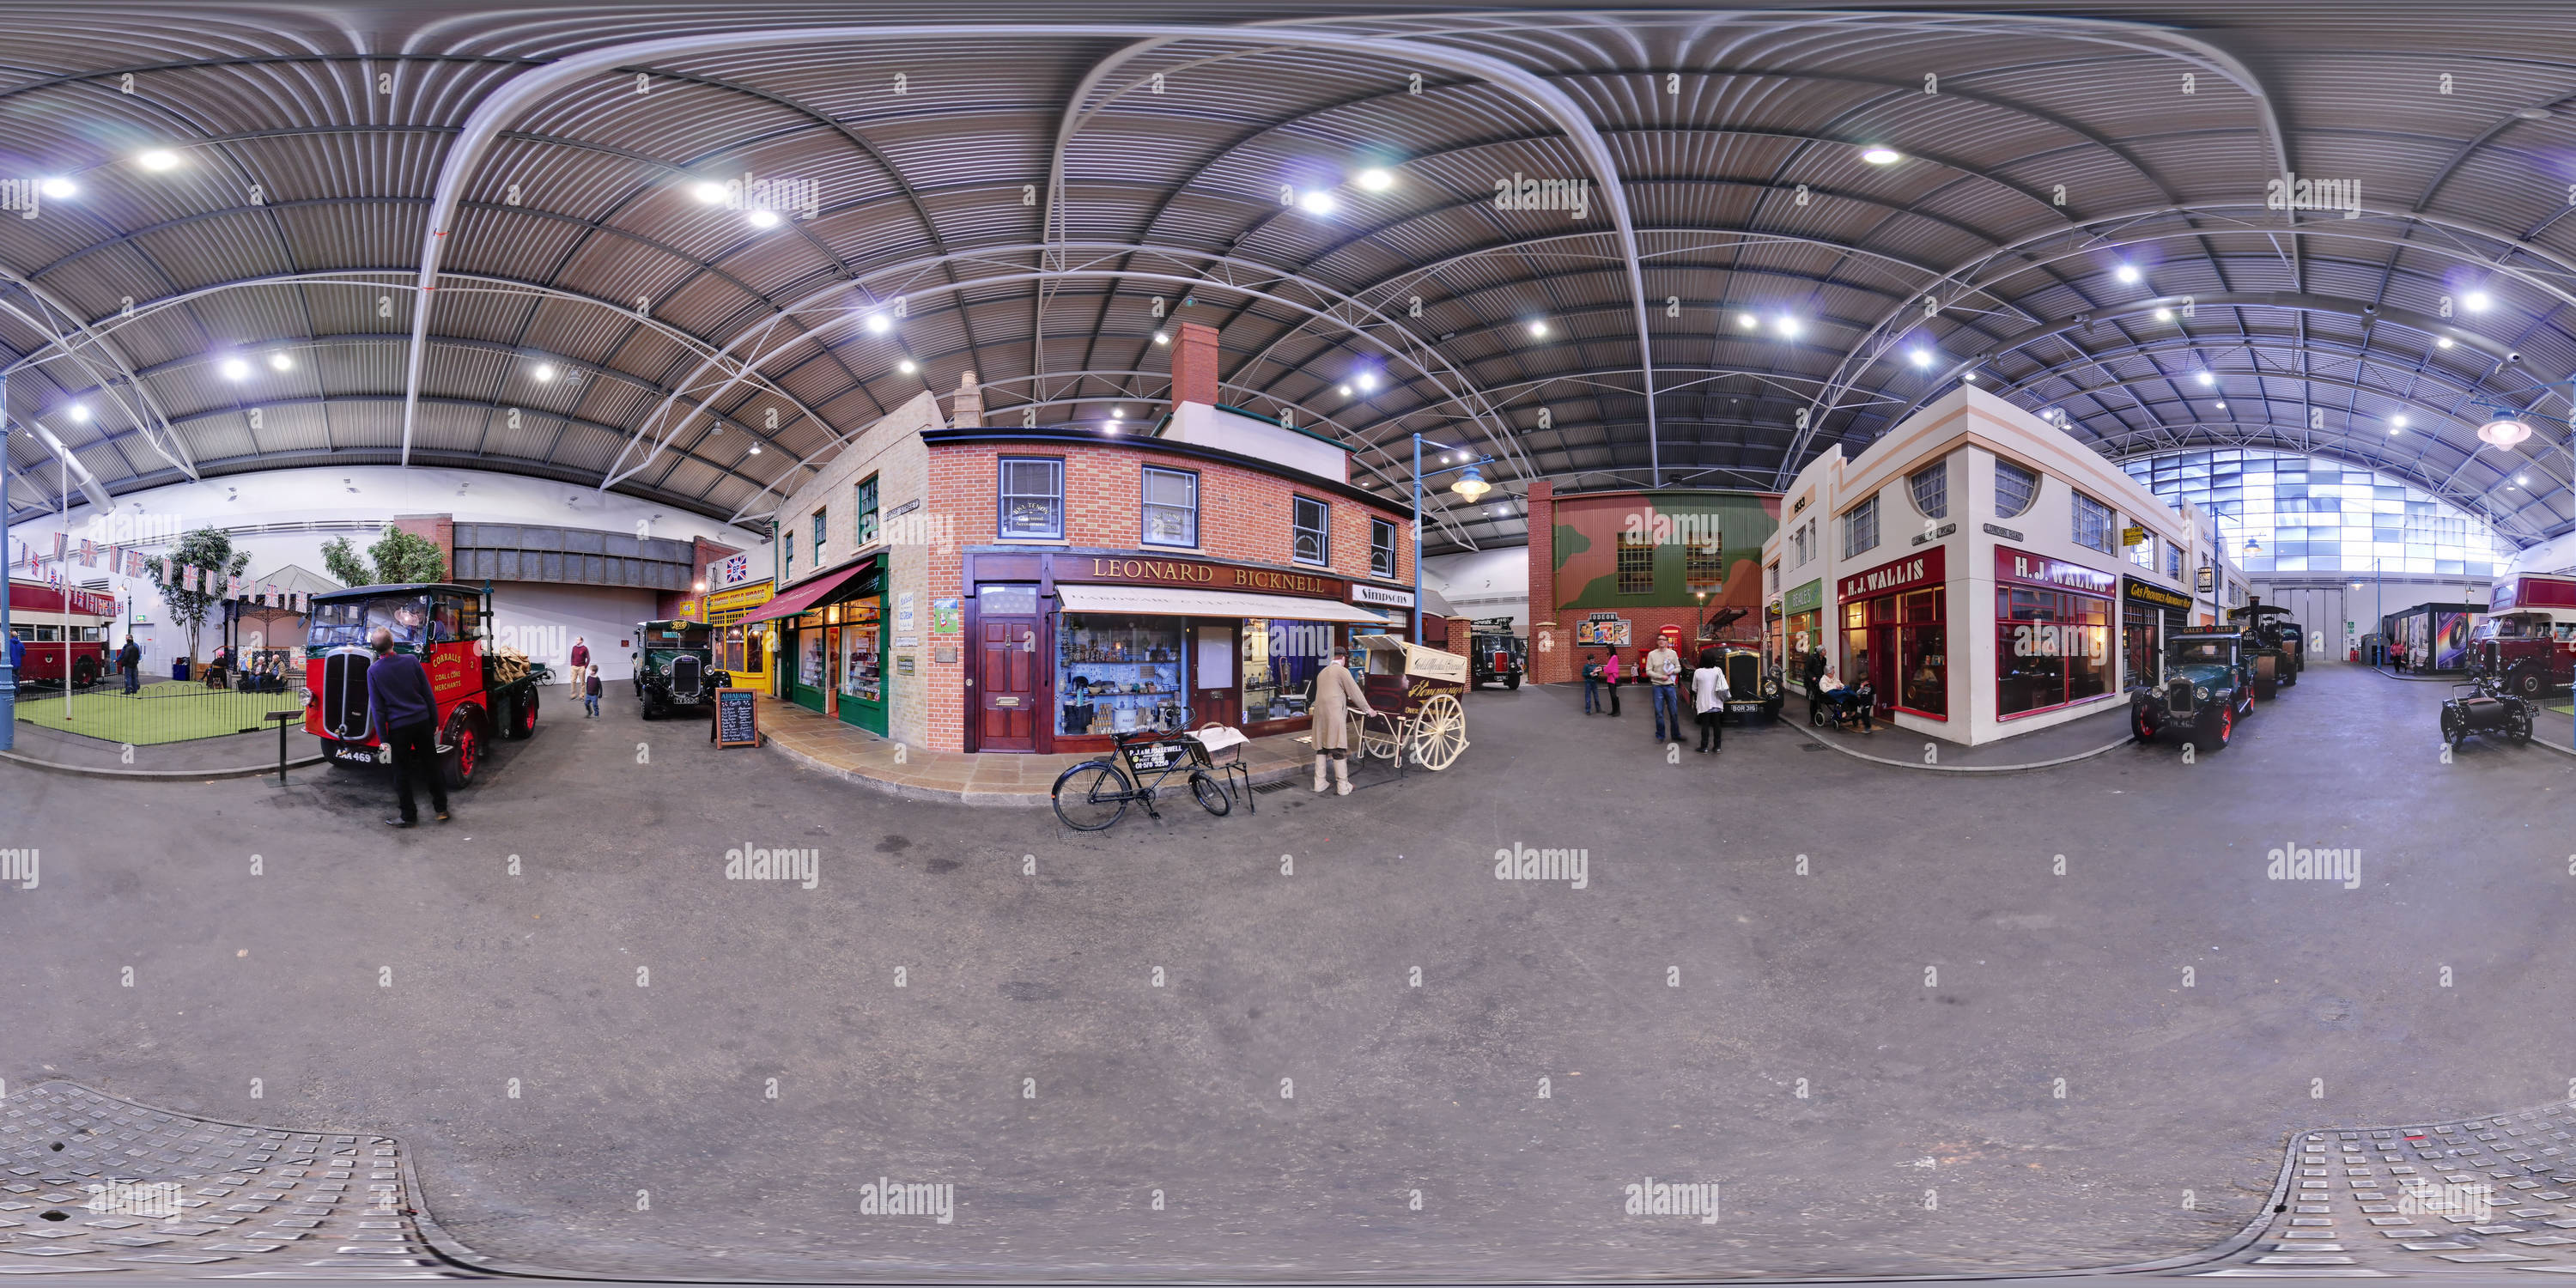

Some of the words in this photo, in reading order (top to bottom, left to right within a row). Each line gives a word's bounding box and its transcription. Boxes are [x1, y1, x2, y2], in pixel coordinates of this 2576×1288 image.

[732, 565, 740, 574] BP
[1092, 558, 1213, 582] LEONARD
[1234, 568, 1325, 593] BICKNELL
[2014, 556, 2049, 581] H.J.
[2050, 563, 2106, 592] WALLIS
[1848, 577, 1867, 597] H.J.
[1868, 558, 1924, 592] WALLIS
[1362, 588, 1407, 604] Simpsons
[433, 653, 461, 668] CORRALLS
[434, 673, 447, 682] COAL
[451, 671, 461, 679] COKE
[434, 680, 461, 692] MERCHANTS
[353, 752, 372, 763] 469
